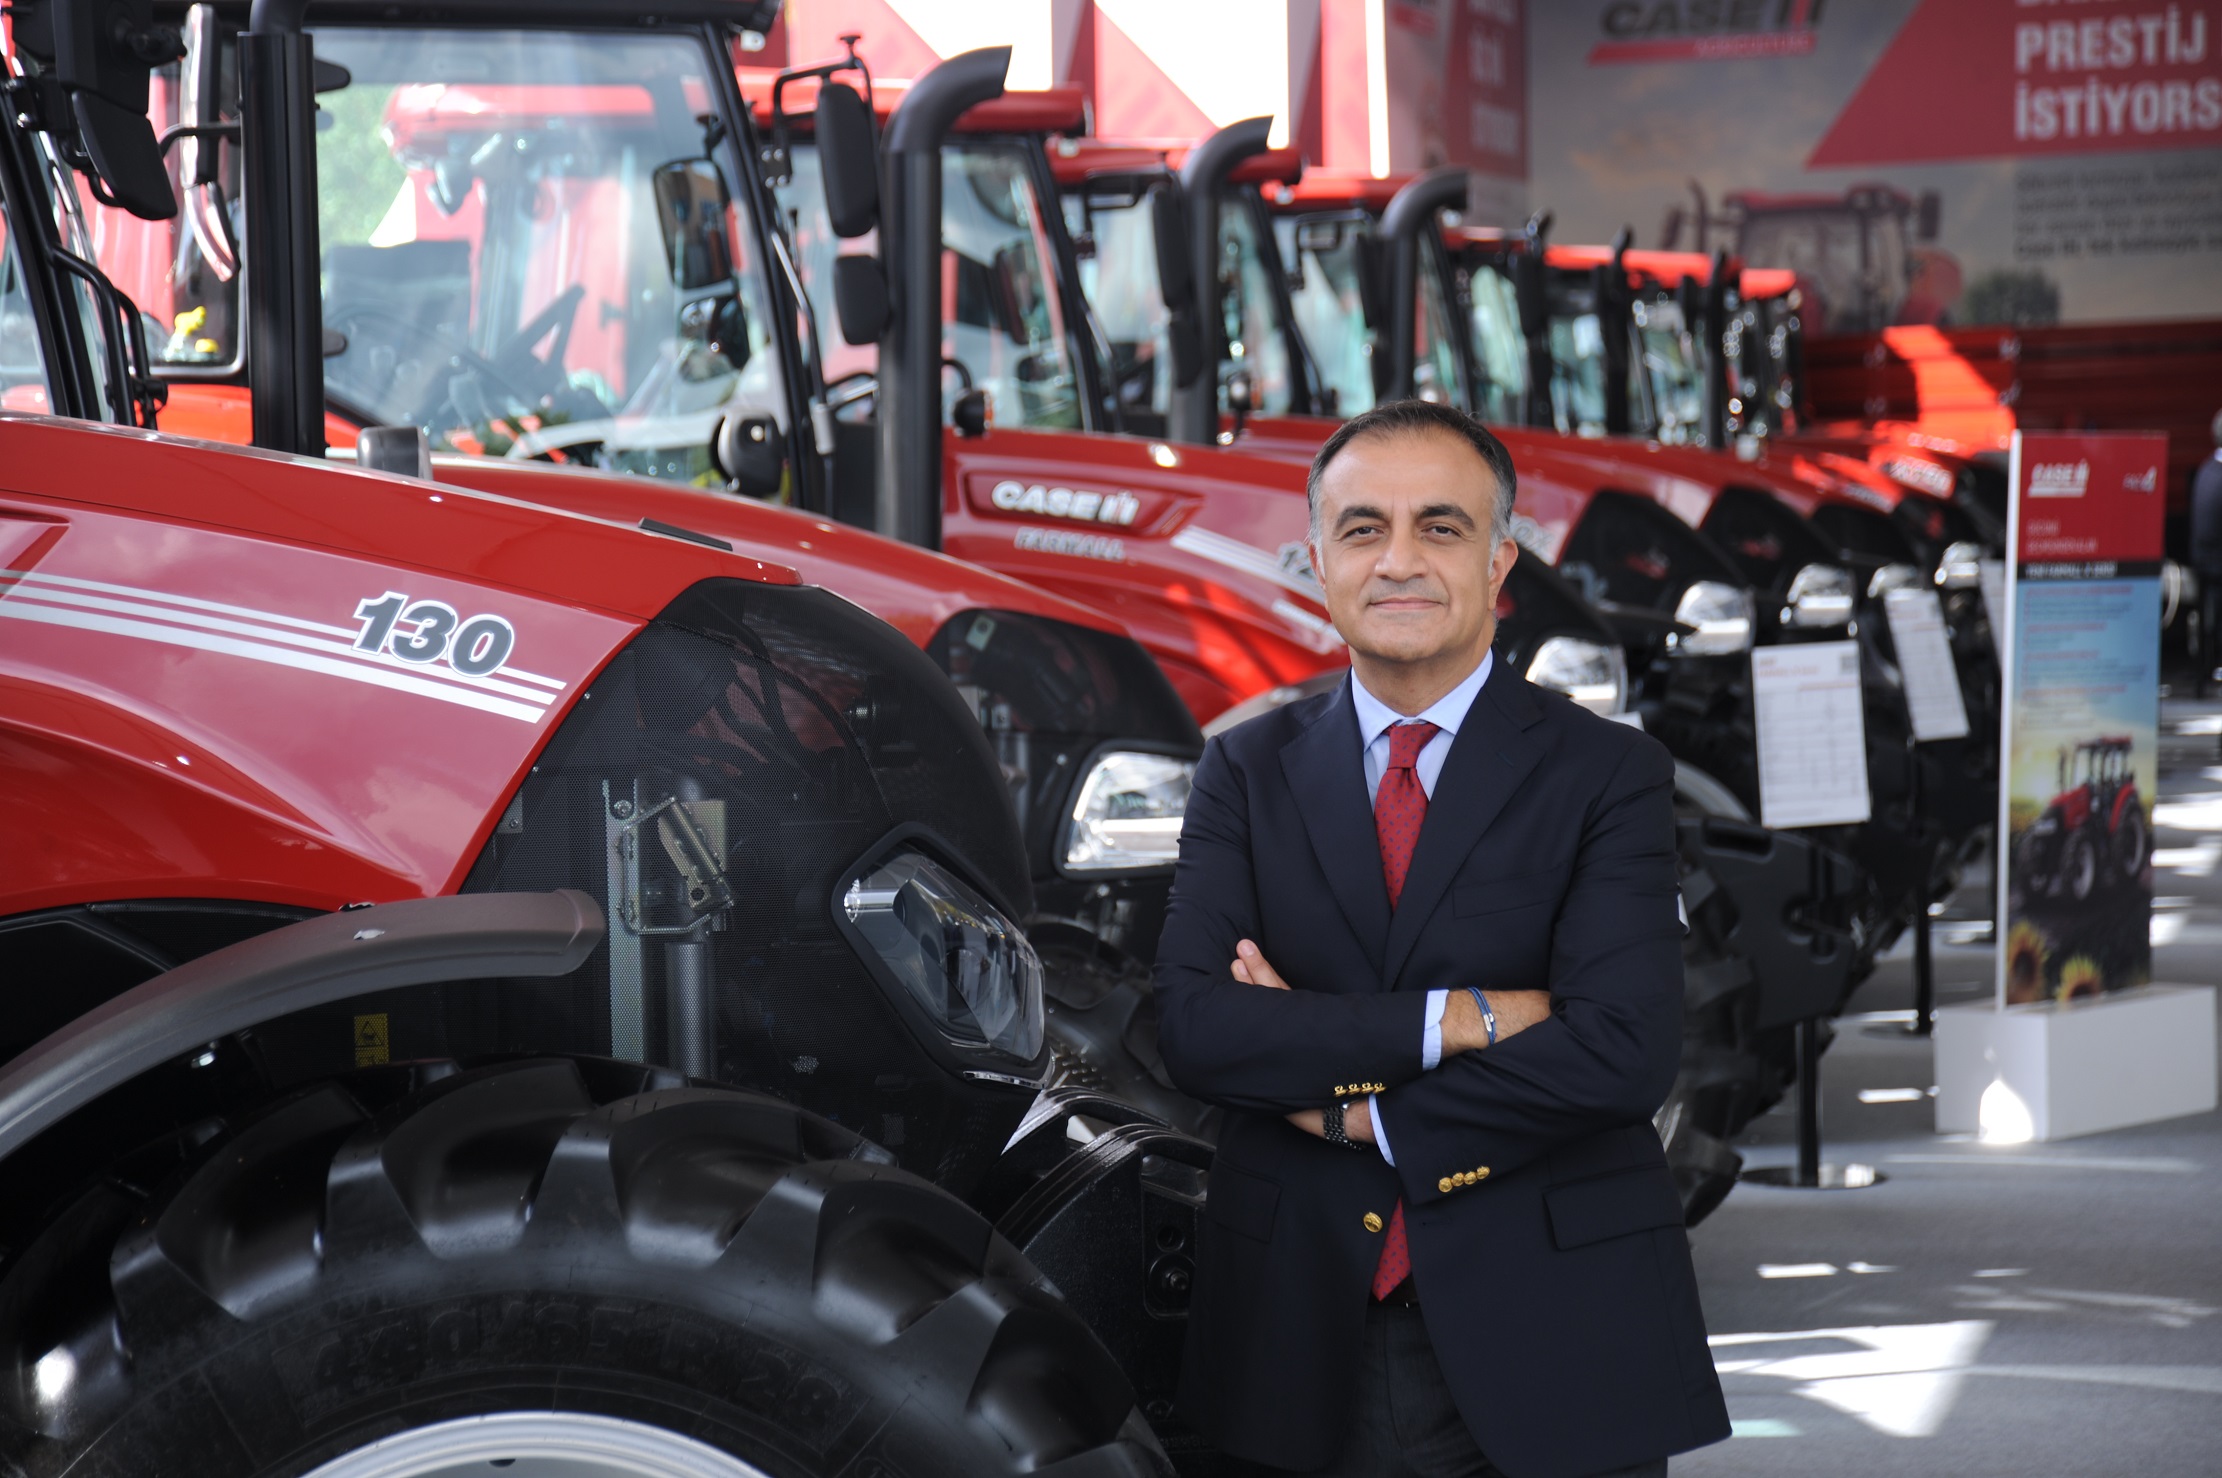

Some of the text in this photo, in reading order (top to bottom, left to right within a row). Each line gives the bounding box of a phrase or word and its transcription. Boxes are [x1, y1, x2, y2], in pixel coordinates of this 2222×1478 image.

[1600, 0, 1764, 37] CASE
[2014, 3, 2208, 74] PRESTİJ
[991, 480, 1101, 520] CASE
[1014, 526, 1125, 561] FARMALL
[351, 590, 514, 678] 130
